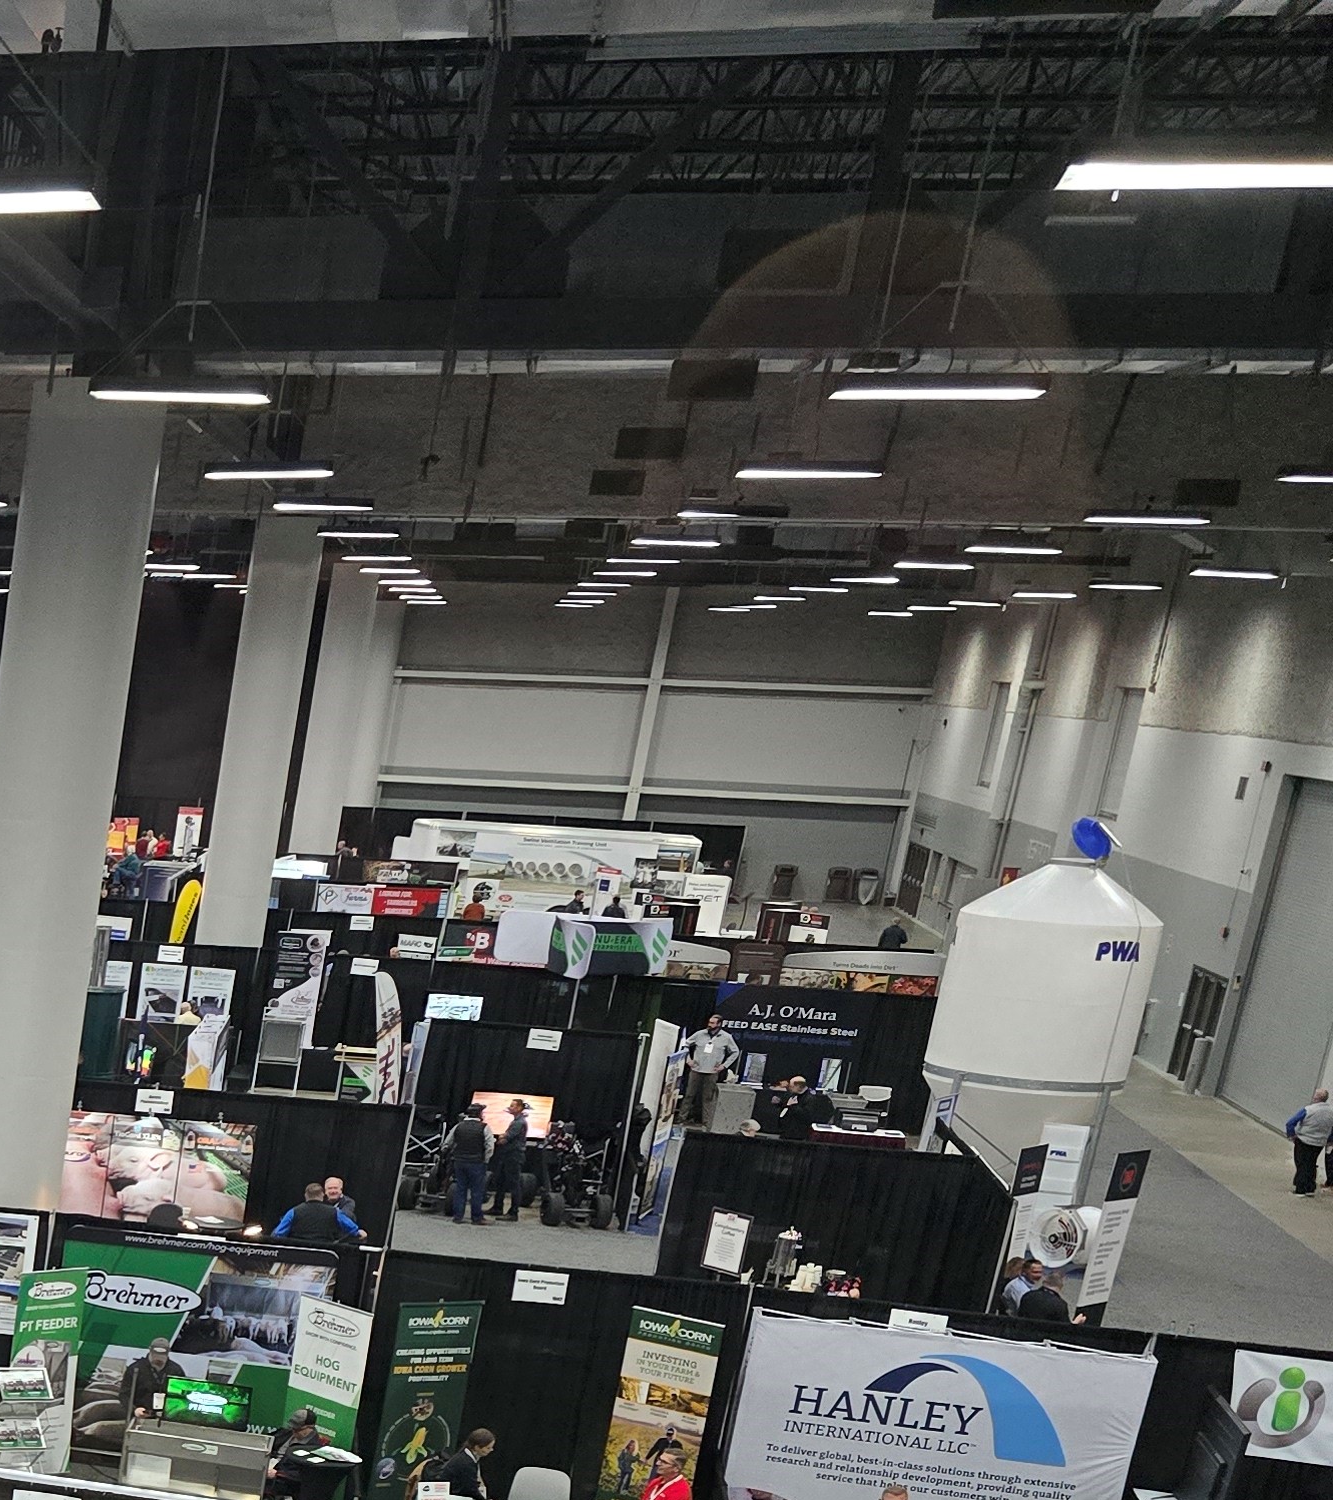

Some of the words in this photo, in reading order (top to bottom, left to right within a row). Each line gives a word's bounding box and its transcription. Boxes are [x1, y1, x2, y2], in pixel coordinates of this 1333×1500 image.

[400, 939, 422, 948] MARC
[1095, 942, 1139, 962] PWA
[748, 1004, 775, 1018] A.J.
[780, 1006, 837, 1021] O'Mara
[721, 1020, 748, 1028] FEED
[751, 1022, 777, 1031] EASE
[780, 1024, 828, 1035] Stainless
[831, 1027, 857, 1037] Steel
[125, 1234, 278, 1257] www.brehmer.com/hog-equipment
[86, 1272, 190, 1310] Brehmer
[19, 1322, 32, 1333] PT
[35, 1317, 78, 1331] FEEDER
[640, 1319, 670, 1333] IOWA
[678, 1328, 712, 1344] CORN
[315, 1354, 341, 1371] HOG
[636, 1359, 644, 1368] IN
[646, 1360, 672, 1372] YOUR
[674, 1365, 694, 1377] FARM
[642, 1351, 697, 1368] INVESTING
[294, 1364, 357, 1393] EQUIPMENT
[640, 1366, 664, 1377] YOUR
[668, 1371, 695, 1384] FUTURE
[788, 1384, 982, 1435] HANLEY
[784, 1420, 932, 1453] INTERNATIONAL
[937, 1439, 970, 1455] LLC
[766, 1444, 780, 1454] To
[783, 1445, 816, 1458] deliver
[820, 1449, 854, 1465] global,
[857, 1453, 921, 1473] best-in-class
[925, 1462, 974, 1478] solutions
[977, 1468, 1023, 1486] through
[1026, 1476, 1076, 1491] extensive
